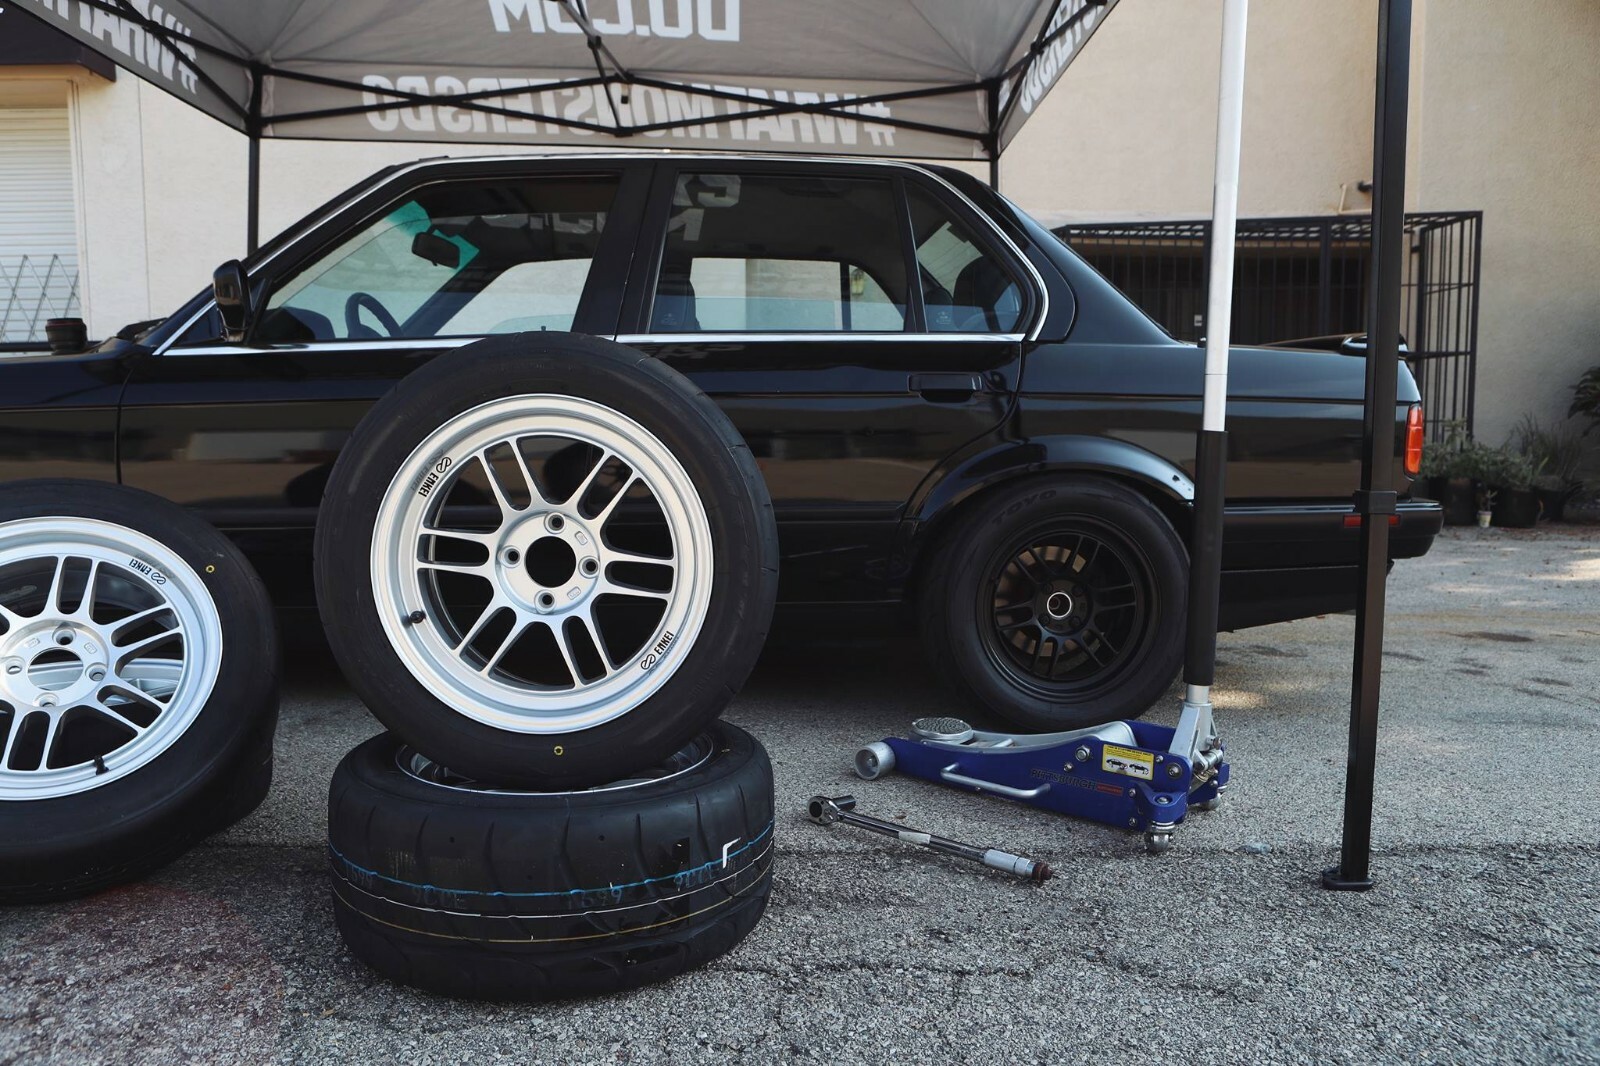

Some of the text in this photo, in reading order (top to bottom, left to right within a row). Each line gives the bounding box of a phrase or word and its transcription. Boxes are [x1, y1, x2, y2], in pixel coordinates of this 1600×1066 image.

[418, 472, 439, 497] ENKEI
[129, 559, 152, 575] ENKEI
[654, 631, 674, 655] ENKEI
